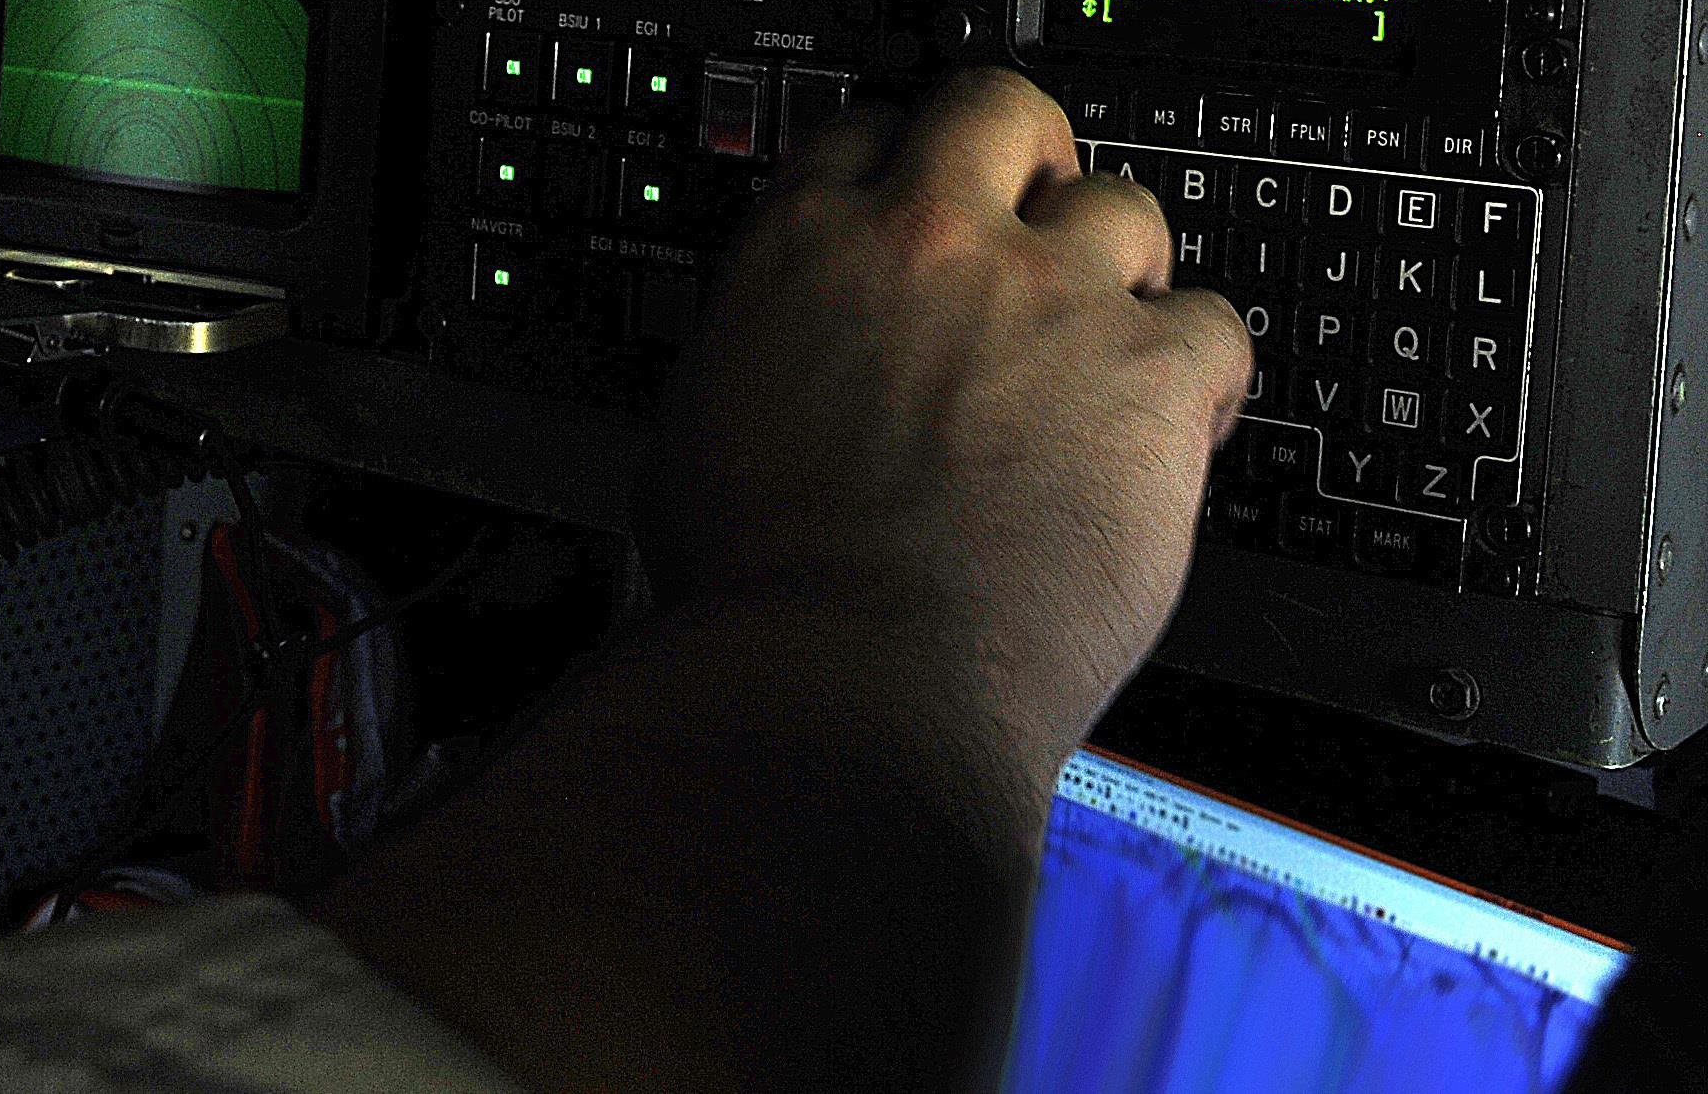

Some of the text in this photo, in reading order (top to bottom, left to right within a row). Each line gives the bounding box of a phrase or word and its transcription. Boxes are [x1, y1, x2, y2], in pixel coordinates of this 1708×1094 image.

[487, 5, 525, 24] PILOT
[557, 12, 589, 30] BSIU
[634, 19, 659, 36] EGI
[753, 30, 815, 52] ZEROIZE
[469, 109, 533, 132] CO-PILOT
[1085, 104, 1107, 120] IFF
[1153, 109, 1176, 127] M3
[1220, 115, 1252, 134] STR
[550, 119, 582, 137] BSIU
[627, 130, 652, 146] EGI
[1290, 123, 1326, 143] FPLN
[1366, 128, 1400, 149] PSN
[1444, 136, 1474, 155] DIR
[1183, 169, 1206, 202] B
[1255, 177, 1278, 208] C
[1329, 184, 1354, 217] D
[1408, 196, 1427, 224] E
[470, 217, 523, 239] NAVGTR
[1484, 201, 1509, 234] F
[590, 236, 695, 266] EGI BATTERIES
[1180, 232, 1204, 265] H
[1326, 251, 1348, 283] J
[1398, 259, 1424, 294] K
[1478, 270, 1503, 305] L
[1318, 315, 1342, 346] P
[1394, 325, 1420, 361] Q
[1473, 336, 1498, 371] R
[1315, 380, 1340, 413] V
[1390, 393, 1414, 423] W
[1465, 402, 1494, 439] X
[1271, 446, 1297, 465] IDX
[1347, 450, 1373, 484] Y
[1422, 463, 1449, 500] Z
[1298, 515, 1334, 537] STAT
[1372, 530, 1412, 551] MARK
